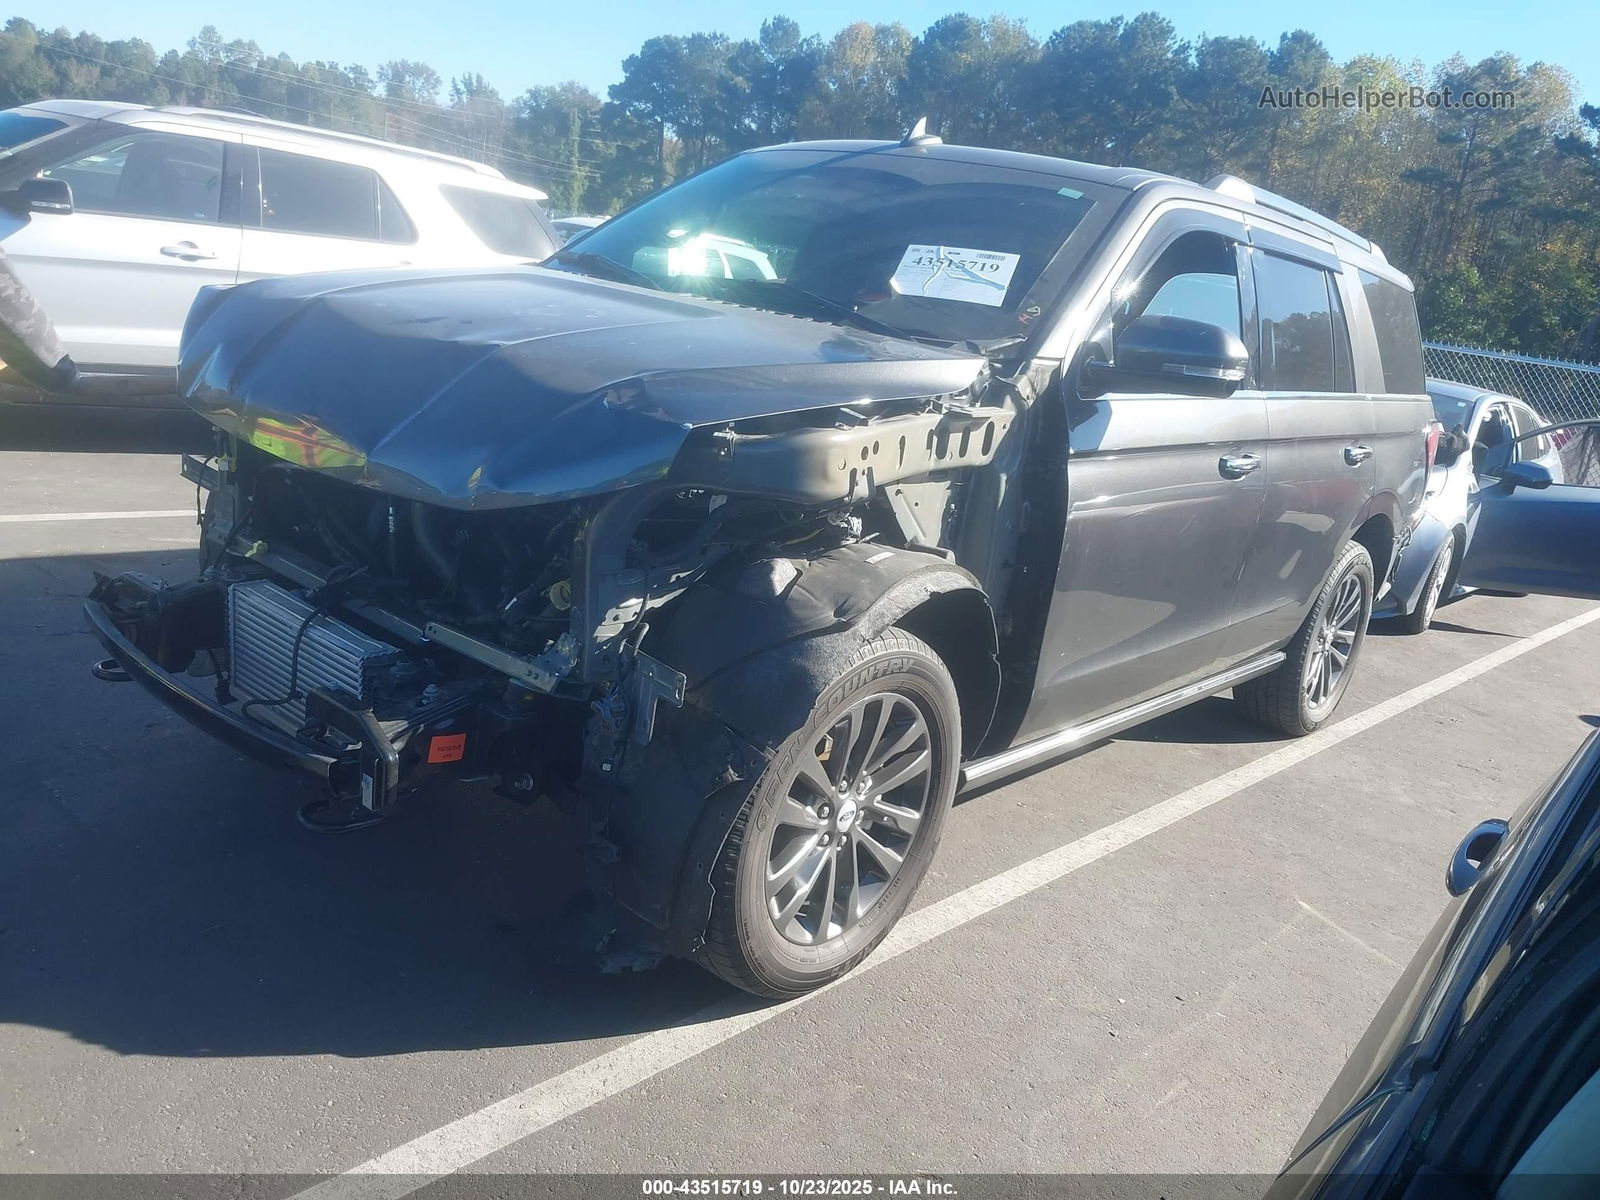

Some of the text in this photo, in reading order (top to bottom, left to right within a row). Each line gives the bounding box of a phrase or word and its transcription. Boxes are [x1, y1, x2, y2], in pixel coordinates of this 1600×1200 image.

[912, 255, 1000, 273] 43515719
[756, 657, 915, 832] OPEN COUNTRY
